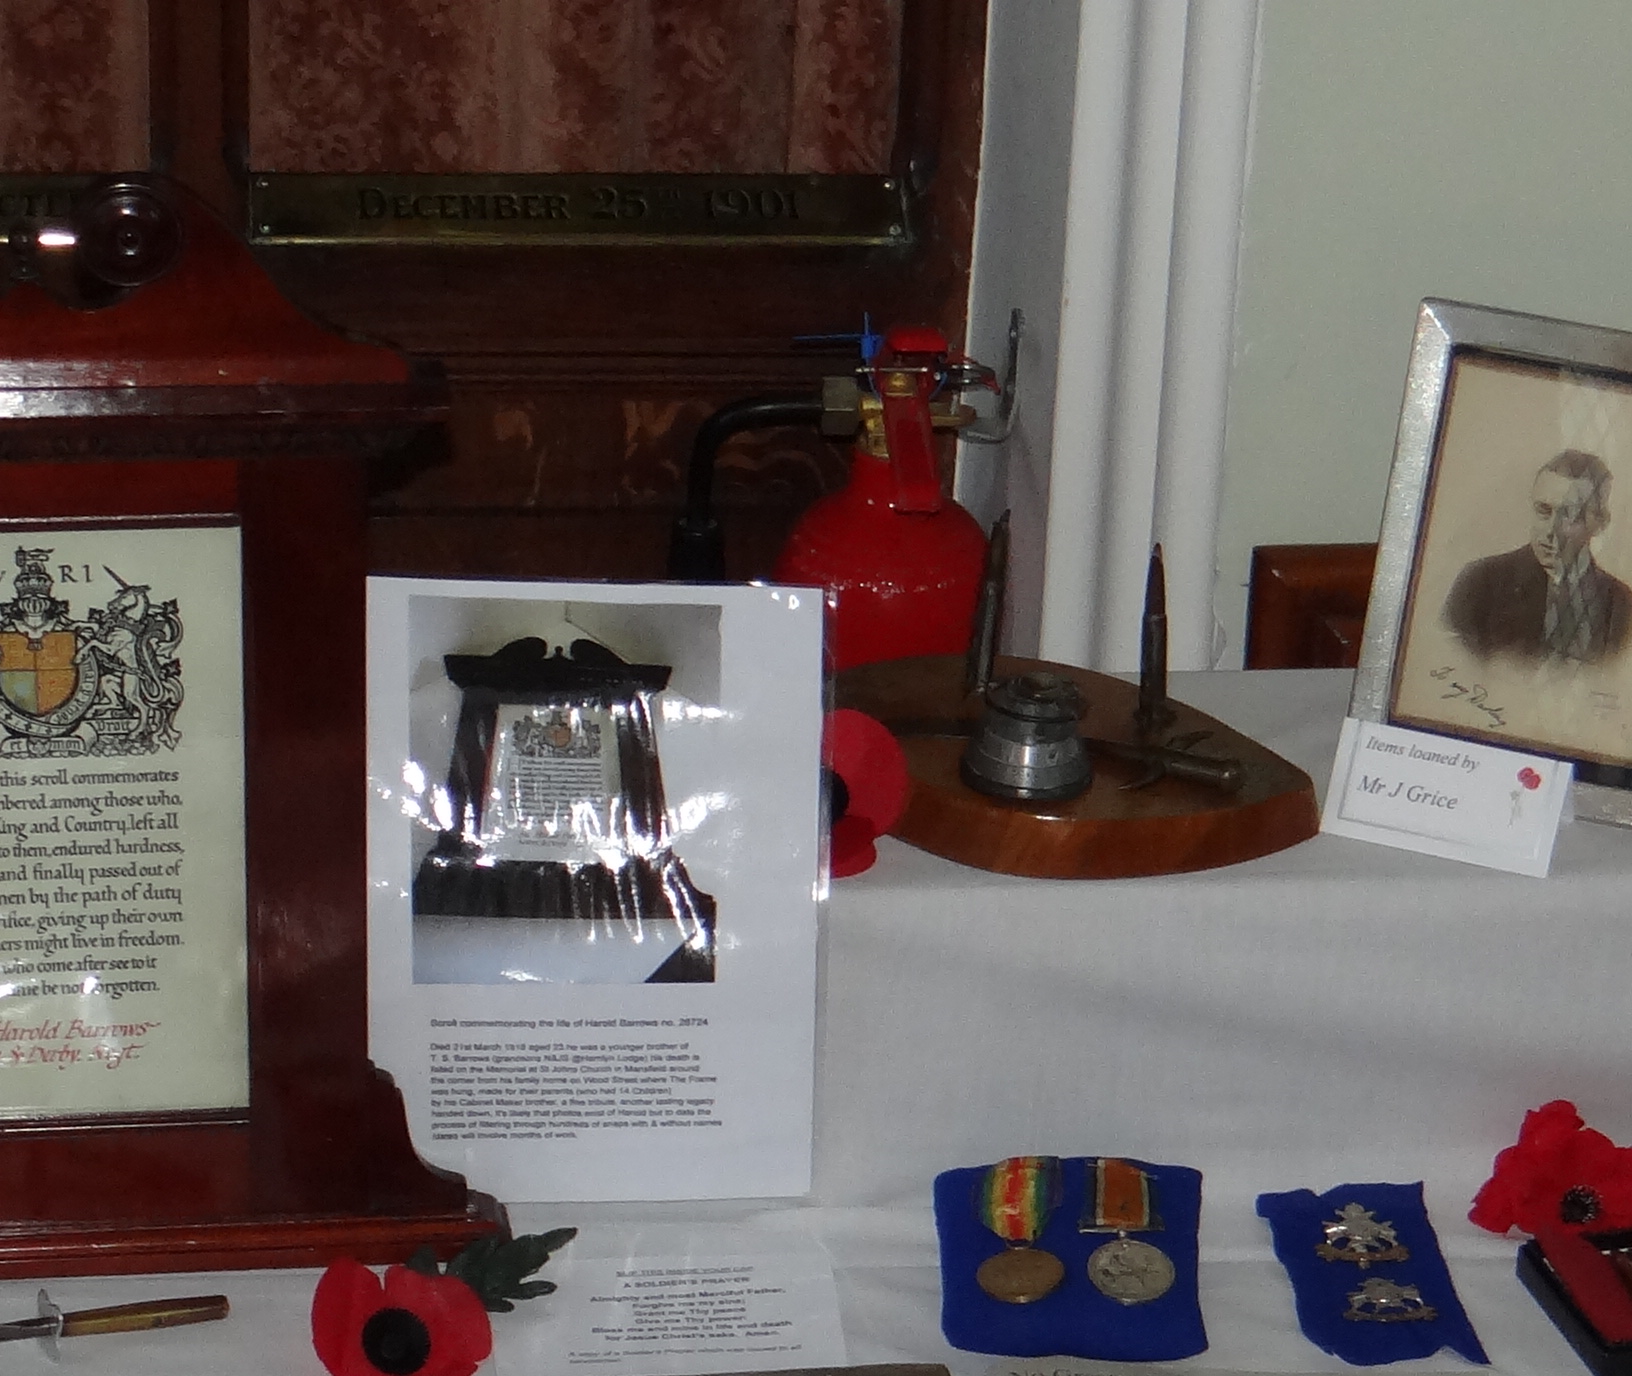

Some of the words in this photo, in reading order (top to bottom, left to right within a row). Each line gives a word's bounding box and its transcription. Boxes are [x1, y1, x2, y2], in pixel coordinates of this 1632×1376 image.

[702, 187, 800, 221] 1901
[1366, 735, 1405, 755] Items
[1408, 744, 1460, 766] loaned
[1461, 755, 1480, 773] by
[0, 770, 28, 787] this
[30, 768, 69, 787] scroll
[71, 769, 179, 786] commemorates
[1357, 775, 1386, 795] Mr
[1388, 782, 1403, 798] J
[1406, 784, 1458, 810] Grice
[30, 816, 60, 834] and
[156, 812, 178, 831] all
[30, 887, 50, 909] by
[53, 886, 79, 904] the
[81, 886, 117, 909] path
[121, 883, 142, 902] of
[143, 883, 182, 905] duty
[24, 935, 69, 958] might
[71, 933, 99, 949] live
[100, 932, 115, 948] in
